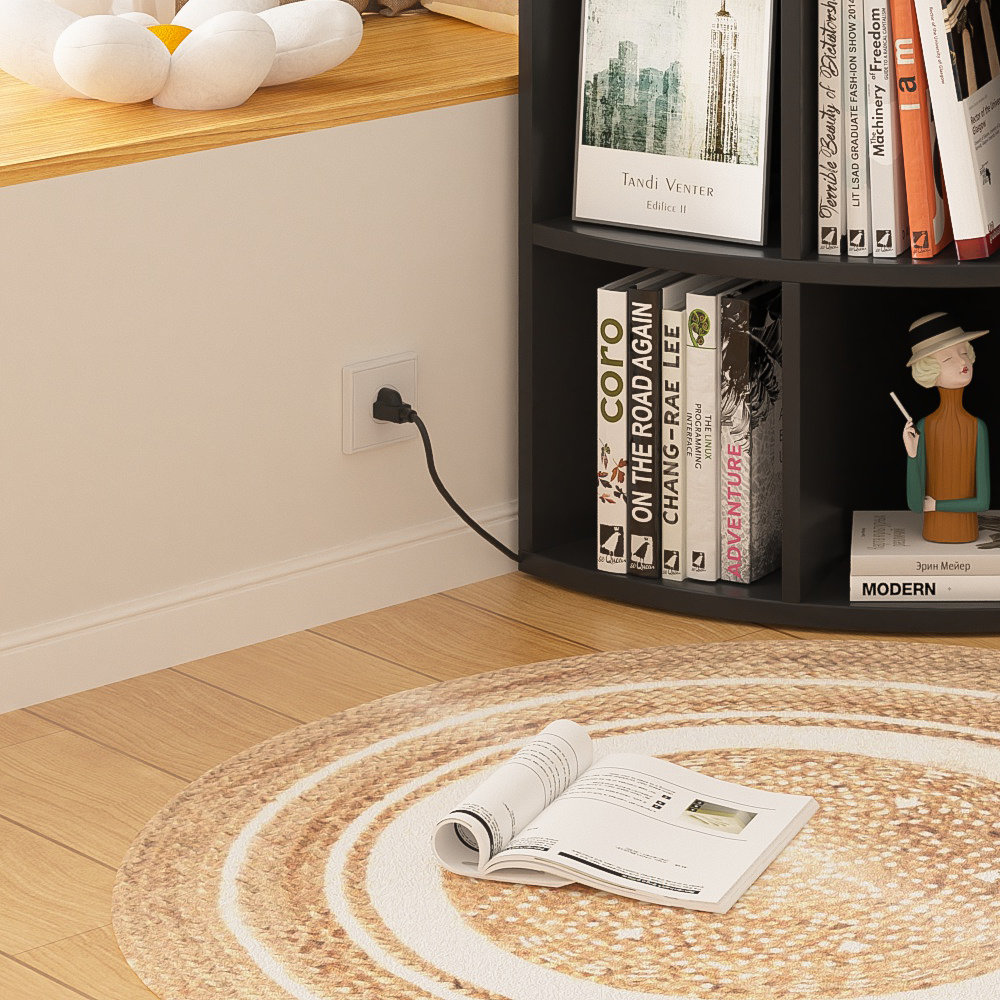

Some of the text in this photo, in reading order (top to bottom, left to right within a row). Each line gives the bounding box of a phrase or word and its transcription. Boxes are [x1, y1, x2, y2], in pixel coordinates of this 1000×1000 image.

[848, 22, 857, 52] SHOW
[867, 8, 882, 72] Freedom
[894, 38, 914, 65] m
[818, 81, 836, 100] of
[849, 56, 858, 102] FASH-ION
[868, 72, 876, 80] of
[898, 76, 917, 93] a
[818, 104, 840, 158] Beauty
[850, 105, 859, 160] GRADUATE
[871, 84, 886, 156] Machinery
[665, 177, 714, 197] VENTER
[818, 161, 839, 218] Terrible
[852, 162, 860, 190] LSAD
[852, 192, 860, 207] LIT
[600, 317, 624, 423] coro
[632, 301, 652, 524] ON THE ROAD AGAIN
[663, 324, 680, 525] CHANG-RAE LEE
[694, 404, 702, 469] PROGRAMMING
[704, 414, 712, 460] THE LINUX
[727, 443, 742, 580] ADVENTURE
[862, 582, 936, 596] MODERN
[916, 561, 971, 573] Эрин Мейер
